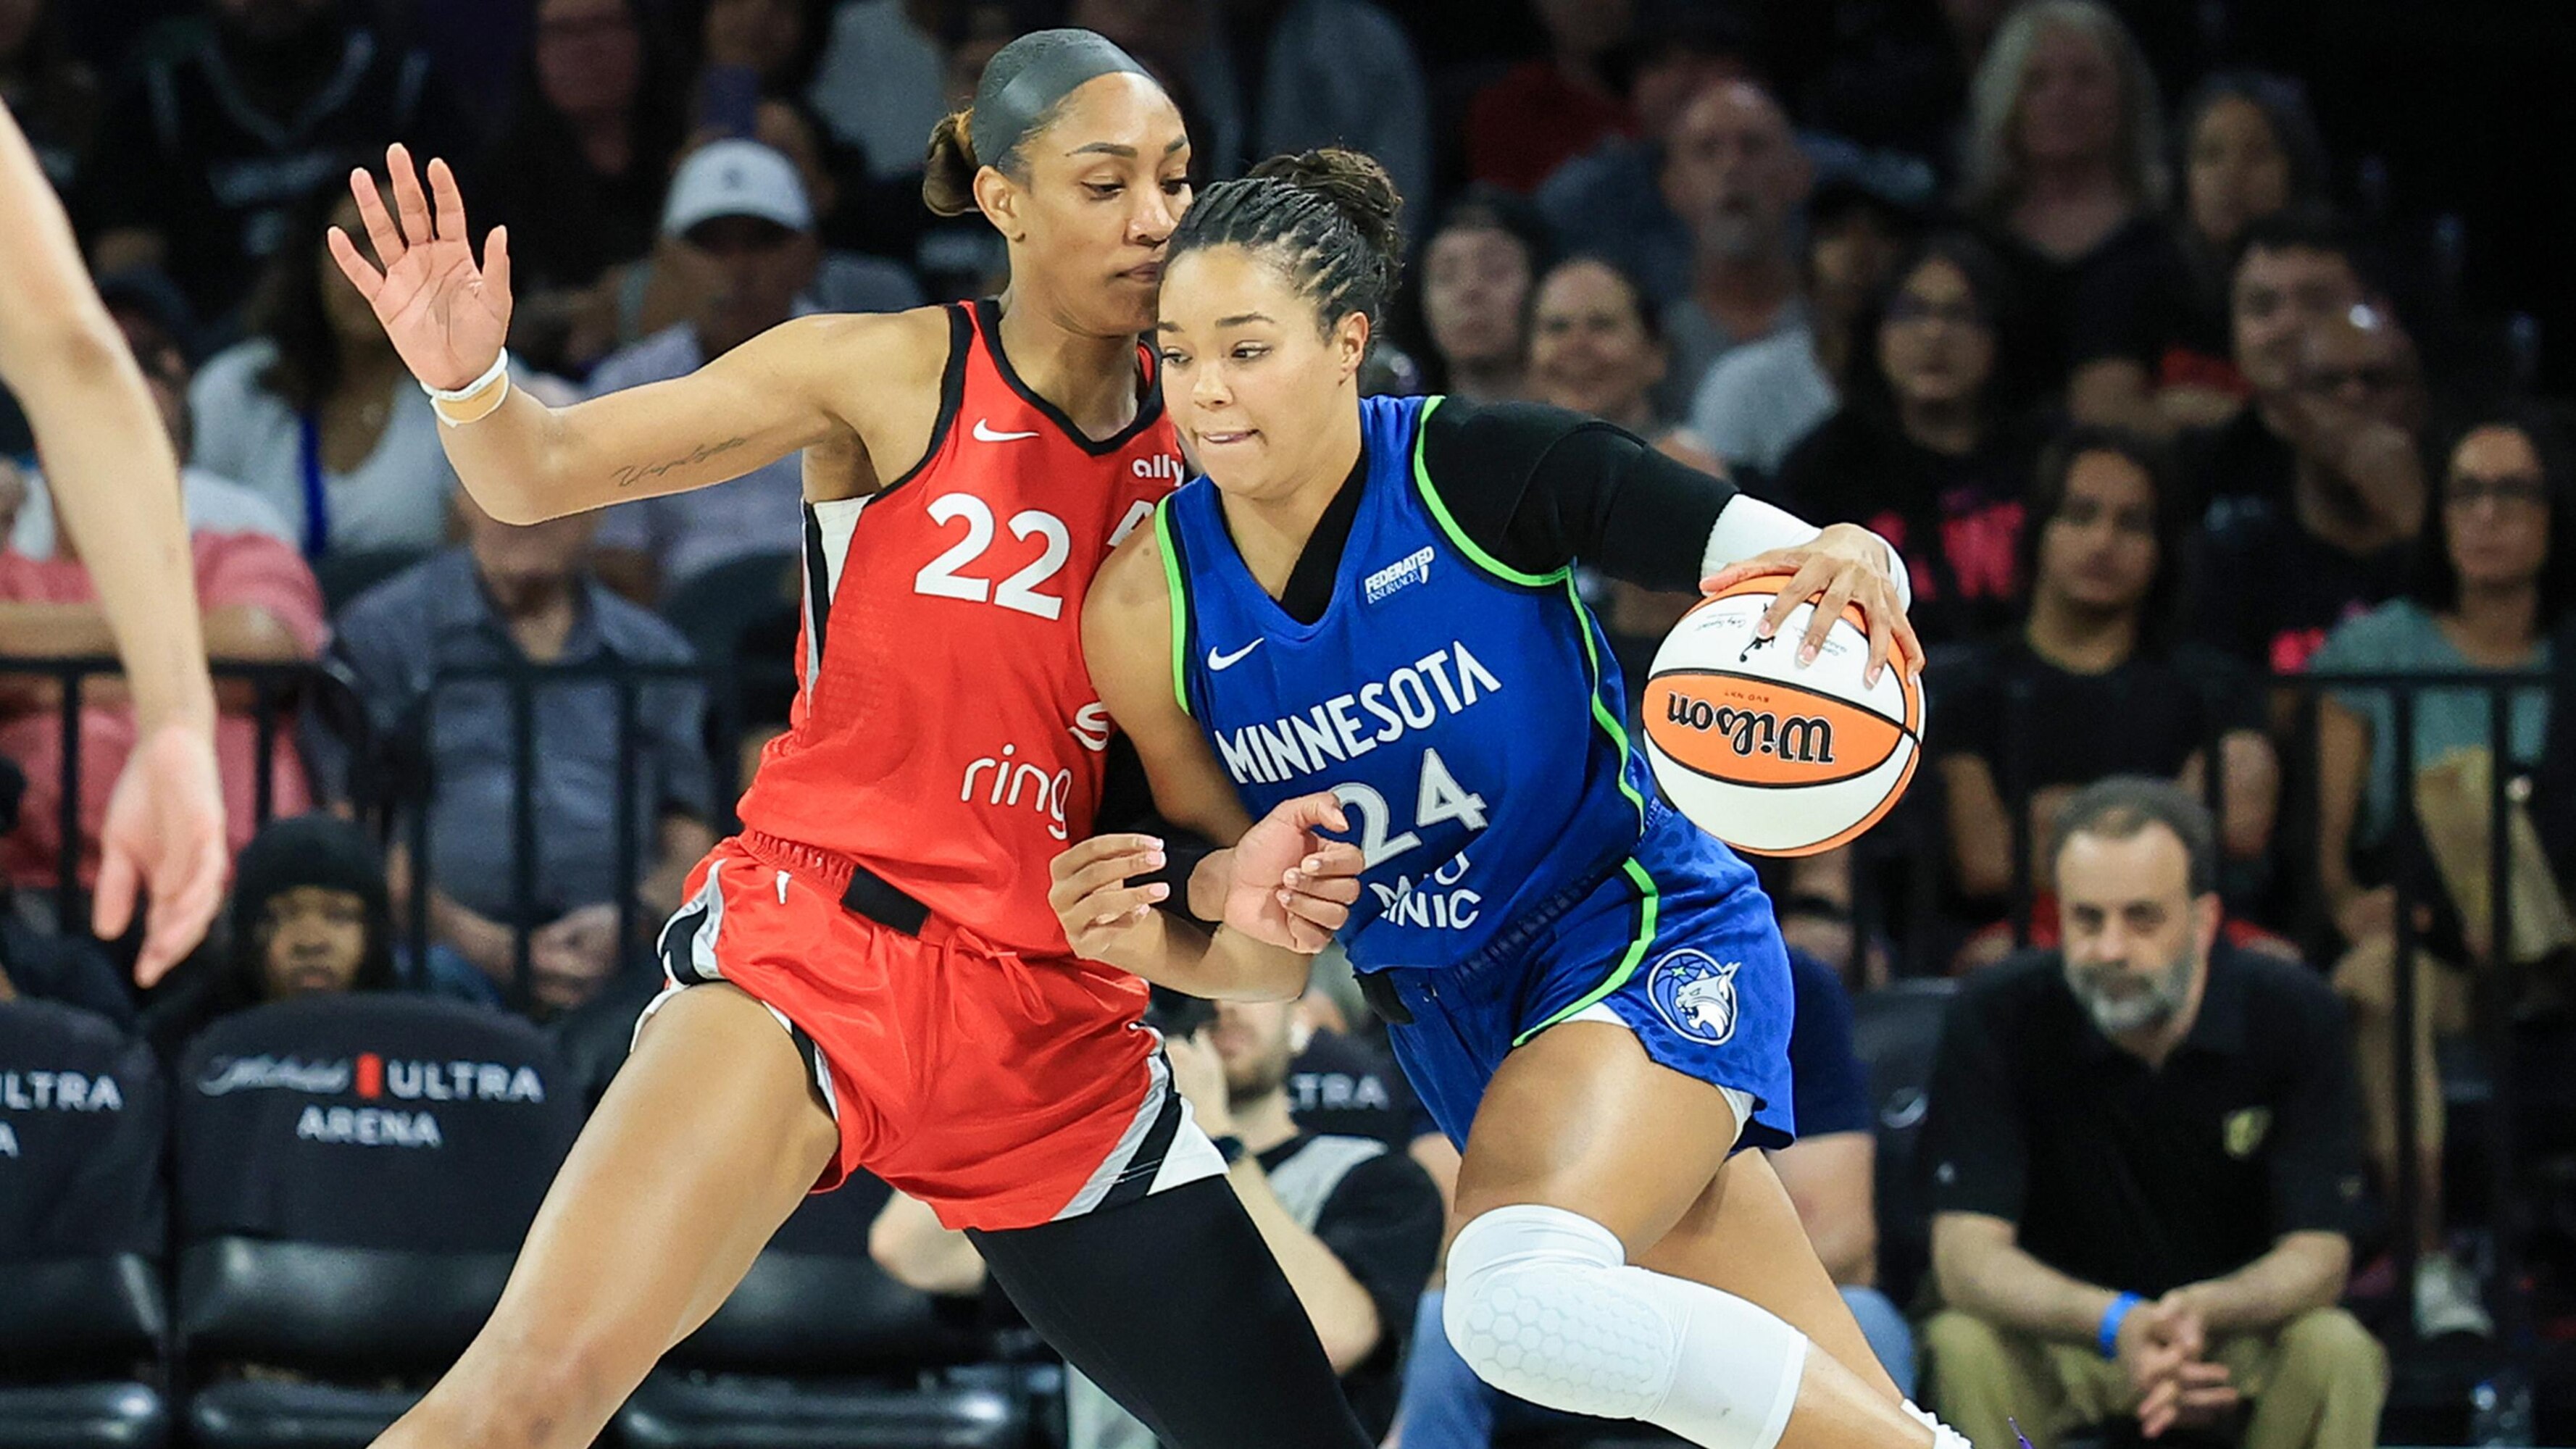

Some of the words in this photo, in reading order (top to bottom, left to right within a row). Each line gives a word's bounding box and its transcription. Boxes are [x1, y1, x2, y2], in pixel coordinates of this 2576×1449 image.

[1132, 454, 1184, 487] ally
[914, 493, 1070, 620] 22
[1364, 546, 1435, 594] FEDERATED
[1214, 640, 1502, 784] MINNESOTA
[1667, 693, 1834, 764] Wilson
[961, 743, 1072, 840] ring
[1329, 747, 1488, 869] 24
[0, 1070, 123, 1111] LTRA
[388, 1058, 546, 1103] ULTRA
[1288, 1073, 1390, 1111] TRA
[296, 1104, 443, 1148] ARENA
